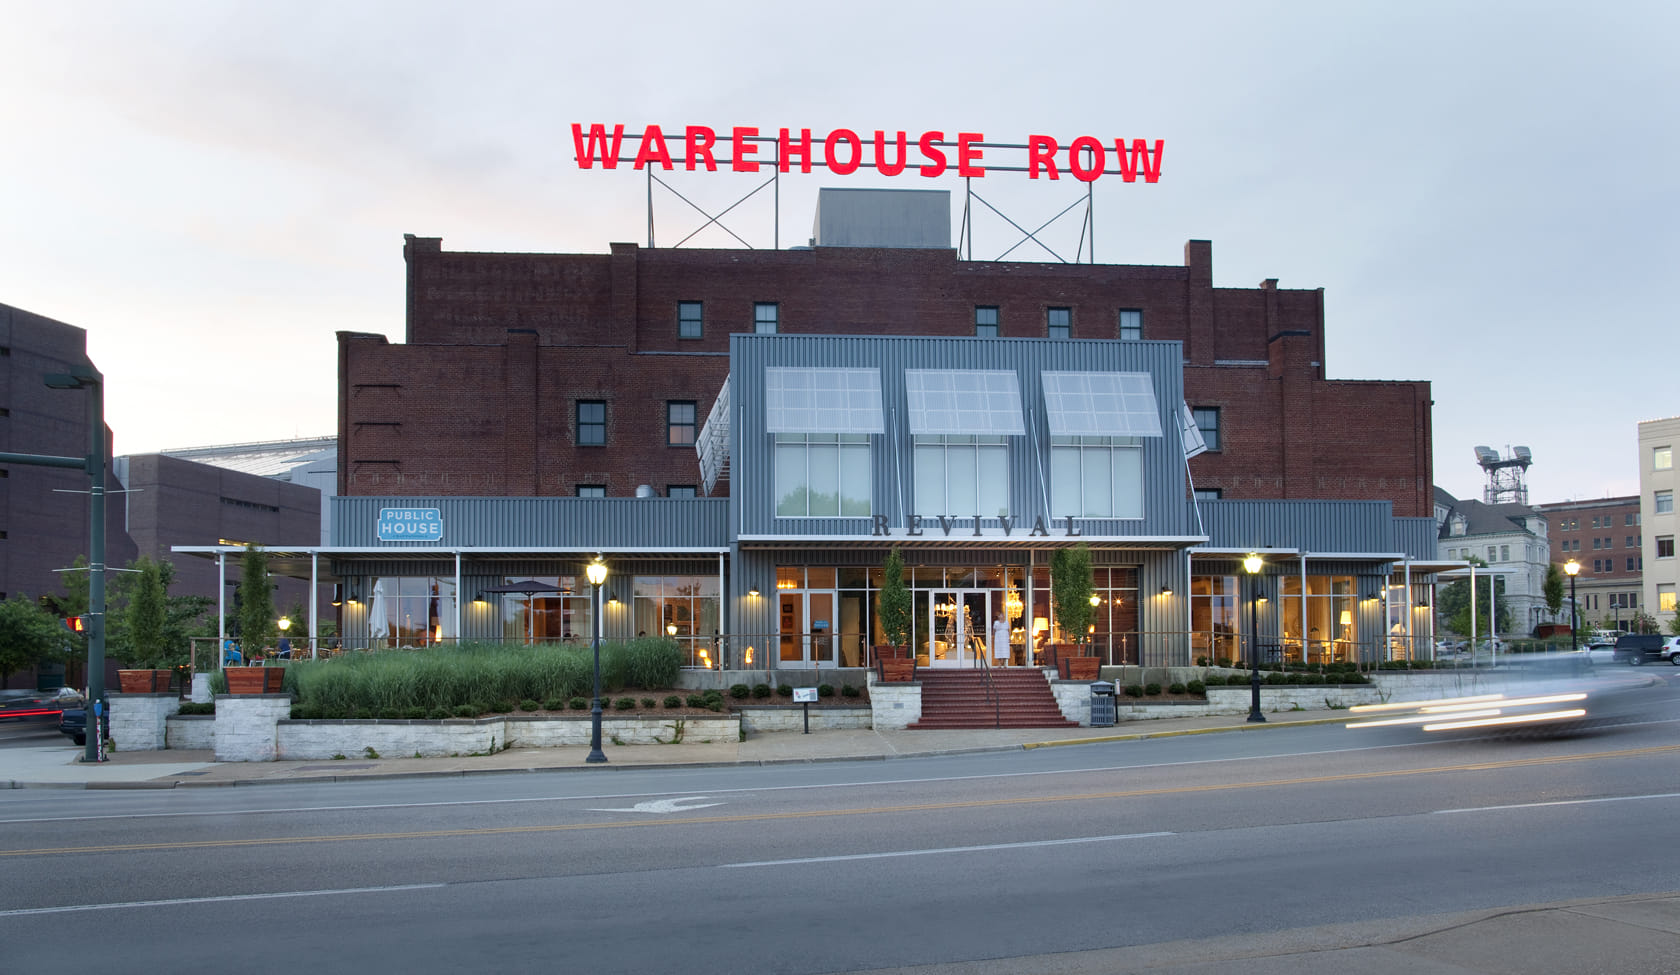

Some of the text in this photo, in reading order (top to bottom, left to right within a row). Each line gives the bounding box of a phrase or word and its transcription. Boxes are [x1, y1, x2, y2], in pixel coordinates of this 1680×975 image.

[571, 123, 1164, 183] WAREHOUSE ROW
[387, 511, 433, 520] PUBLIC
[382, 523, 439, 534] HOUSE
[872, 514, 1081, 537] REVIVAL
